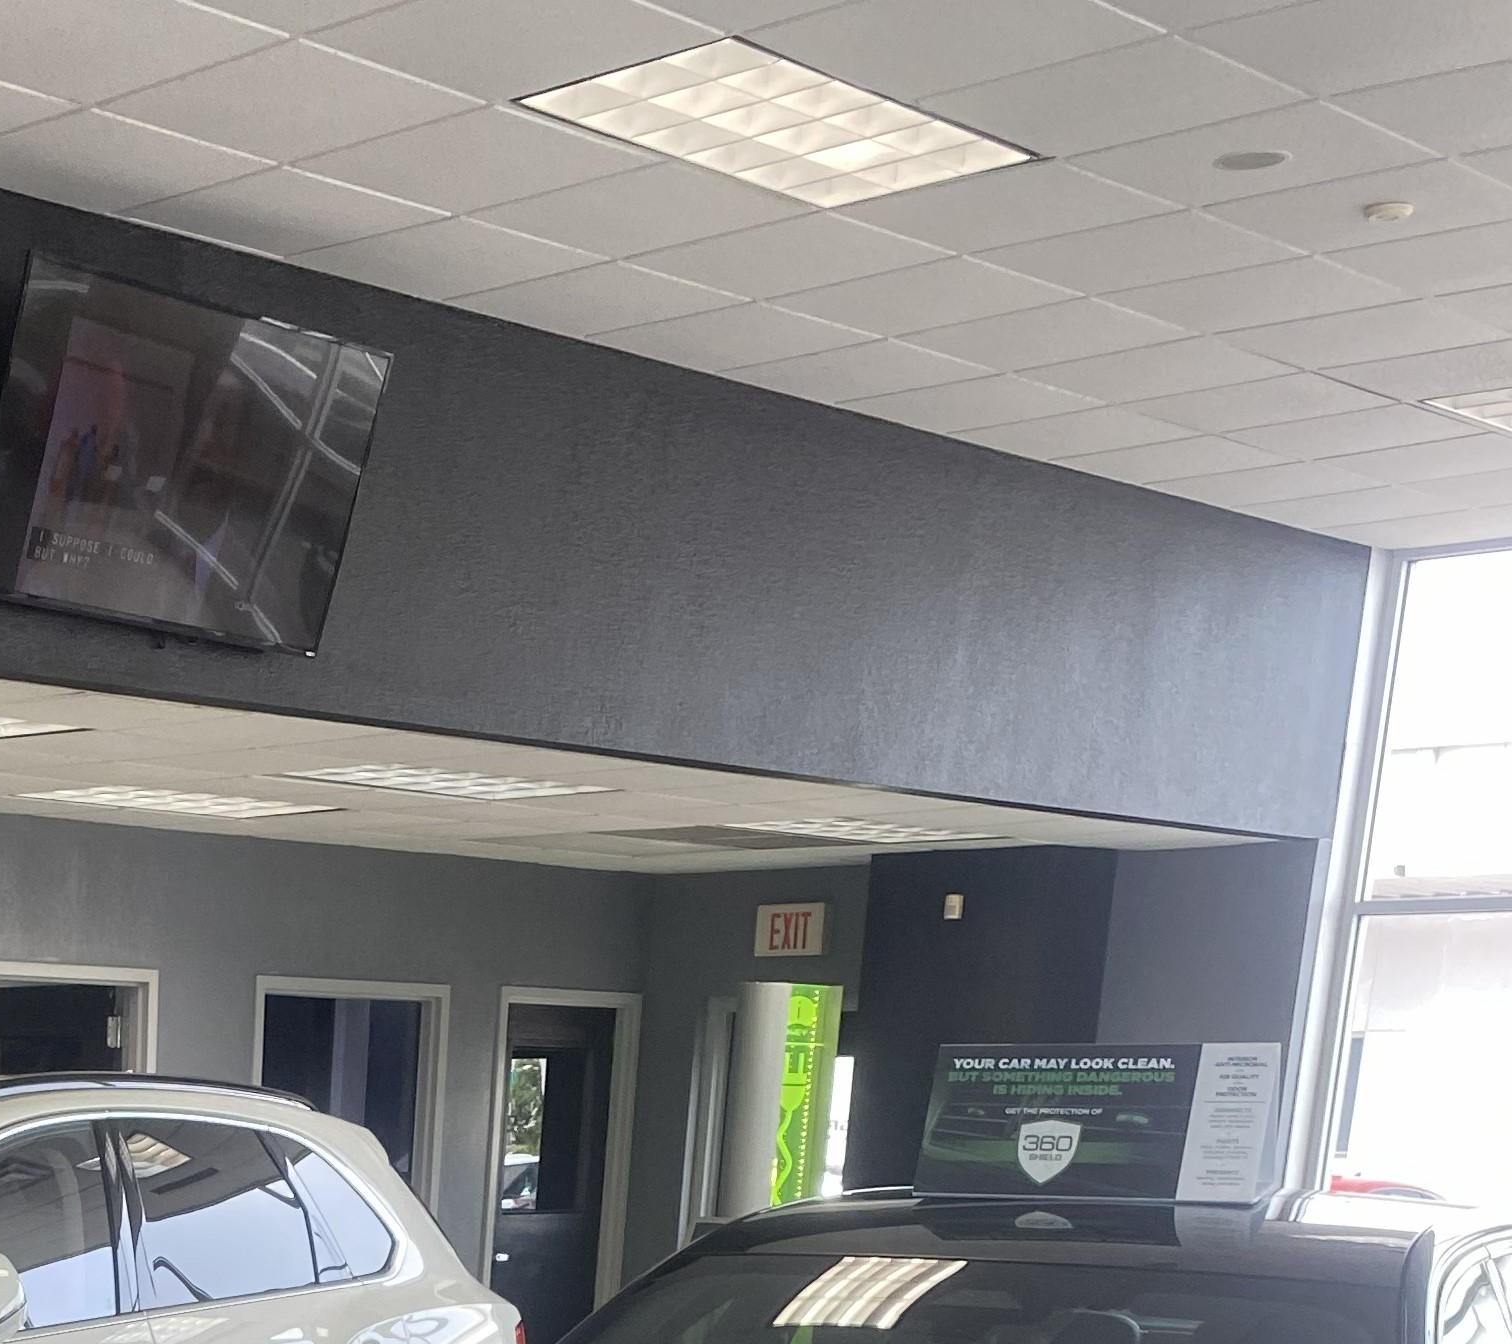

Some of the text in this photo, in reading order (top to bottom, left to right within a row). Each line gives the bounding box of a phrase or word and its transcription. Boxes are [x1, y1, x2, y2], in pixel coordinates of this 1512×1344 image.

[52, 533, 101, 554] SUPPOSE
[34, 546, 57, 561] BUT
[769, 912, 813, 950] EXIT
[953, 1058, 1175, 1069] YOUR CAR MAY LOOK CLEAN.
[948, 1071, 1175, 1083] BUT SOMETHING DANGEROUS
[993, 1084, 1123, 1096] IS HIDING INSIDE.
[1005, 1107, 1103, 1115] GET THE PROTECTION OF
[1022, 1135, 1073, 1151] 360
[1029, 1153, 1062, 1161] SHIELD
